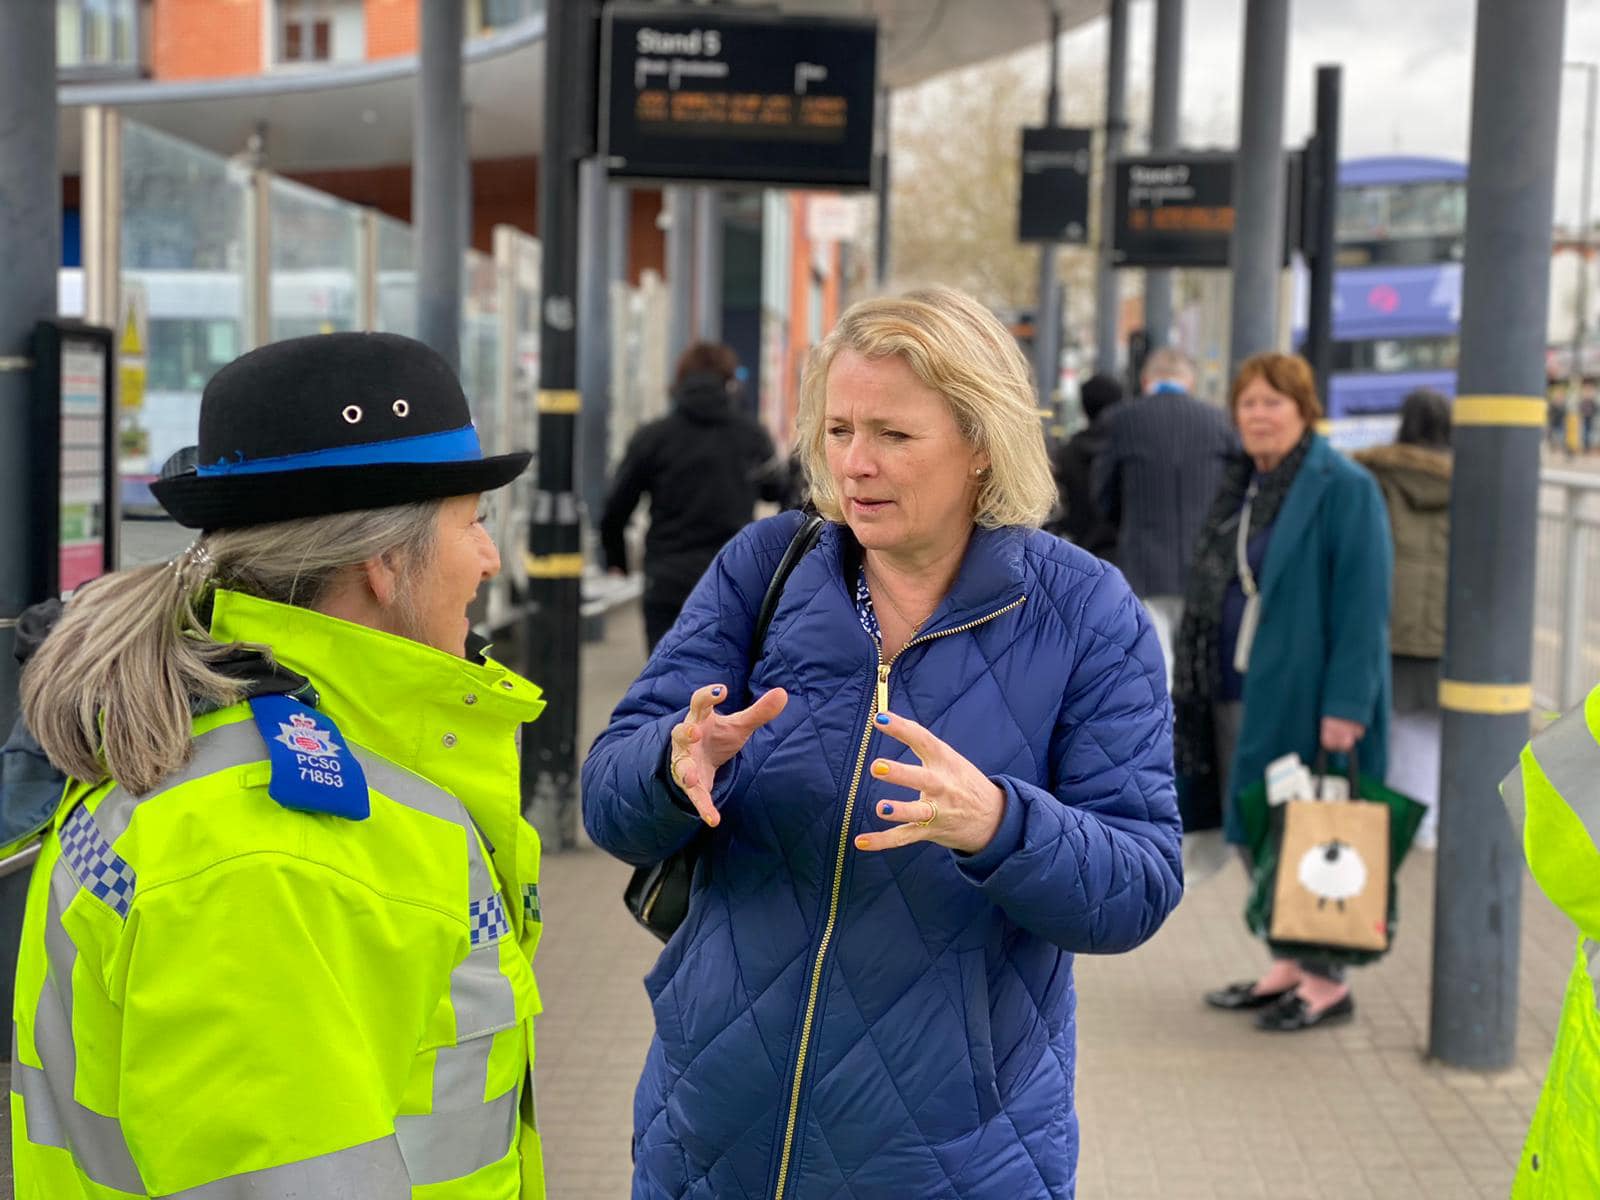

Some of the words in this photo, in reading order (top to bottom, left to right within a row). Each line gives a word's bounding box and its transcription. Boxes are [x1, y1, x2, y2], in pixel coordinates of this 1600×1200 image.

[636, 27, 702, 55] Stand
[703, 30, 721, 56] 5
[1130, 165, 1174, 185] Stand
[296, 754, 341, 772] PCSO
[298, 767, 344, 788] 71853
